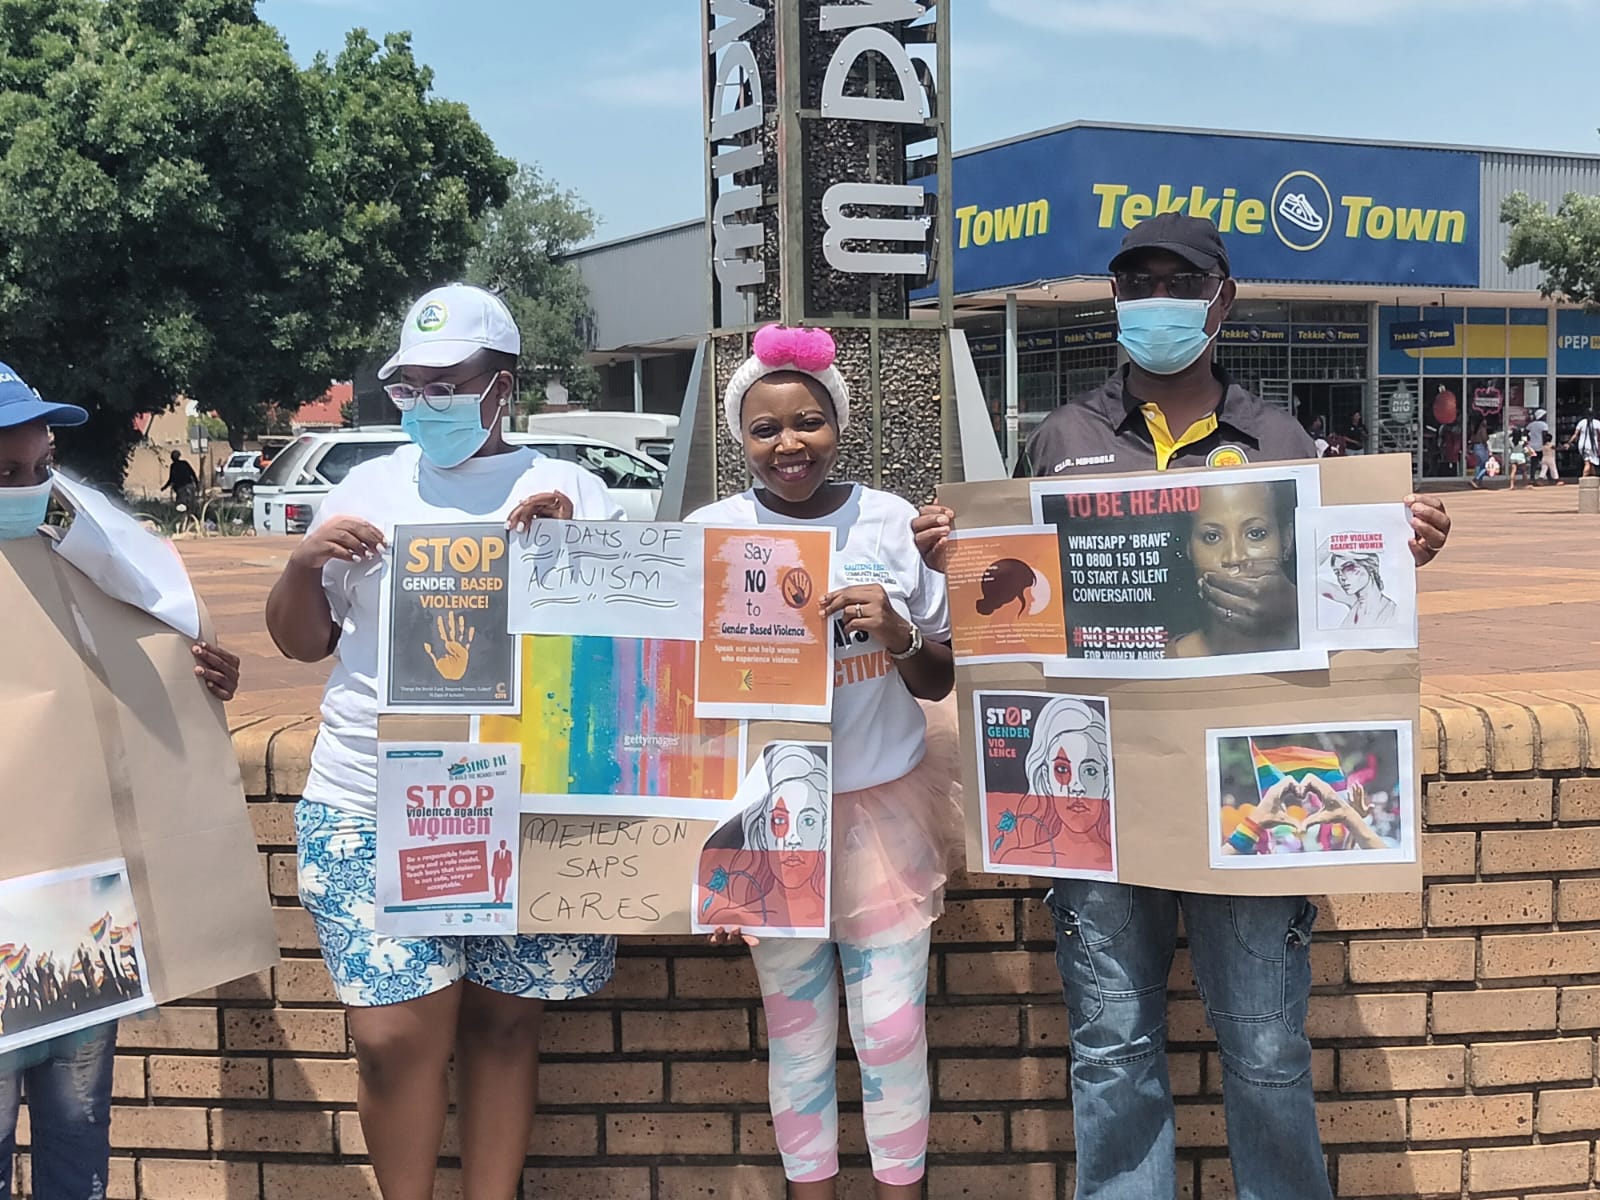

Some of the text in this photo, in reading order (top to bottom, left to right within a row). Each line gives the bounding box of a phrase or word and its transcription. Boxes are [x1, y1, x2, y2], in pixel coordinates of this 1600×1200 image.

[1093, 183, 1466, 243] Tekkie Town
[956, 198, 1050, 249] Town
[1220, 329, 1285, 339] Tekkie Town
[1298, 330, 1360, 339] Tekkie Town
[1564, 335, 1589, 349] PEP
[1065, 486, 1201, 518] TO BE HEARD
[565, 524, 623, 548] DAYS
[639, 527, 683, 552] OF
[1068, 535, 1126, 549] WHATSAPP
[1330, 533, 1382, 543] STOP VIOLENCE
[405, 536, 505, 573] STOP
[744, 543, 772, 565] Say
[1069, 551, 1160, 567] TO 0800 150 150
[402, 577, 503, 591] GENDER BASED
[528, 564, 661, 592] ACTIVISM
[744, 569, 766, 593] NO
[1071, 568, 1169, 585] TO START A SILENT
[420, 595, 489, 609] VIOLENCE!
[1072, 587, 1156, 603] CONVERSATION.
[746, 598, 761, 617] to
[721, 622, 805, 637] Gender Based Violence
[1105, 626, 1166, 648] EXCUSE
[986, 706, 1032, 725] STOP
[987, 726, 1030, 738] GENDER
[987, 739, 1005, 748] VIO
[988, 748, 1017, 758] LENCE
[406, 785, 494, 809] STOP
[406, 806, 493, 818] violence against
[408, 816, 491, 838] women
[557, 855, 639, 878] SAPS
[529, 891, 661, 922] CARES
